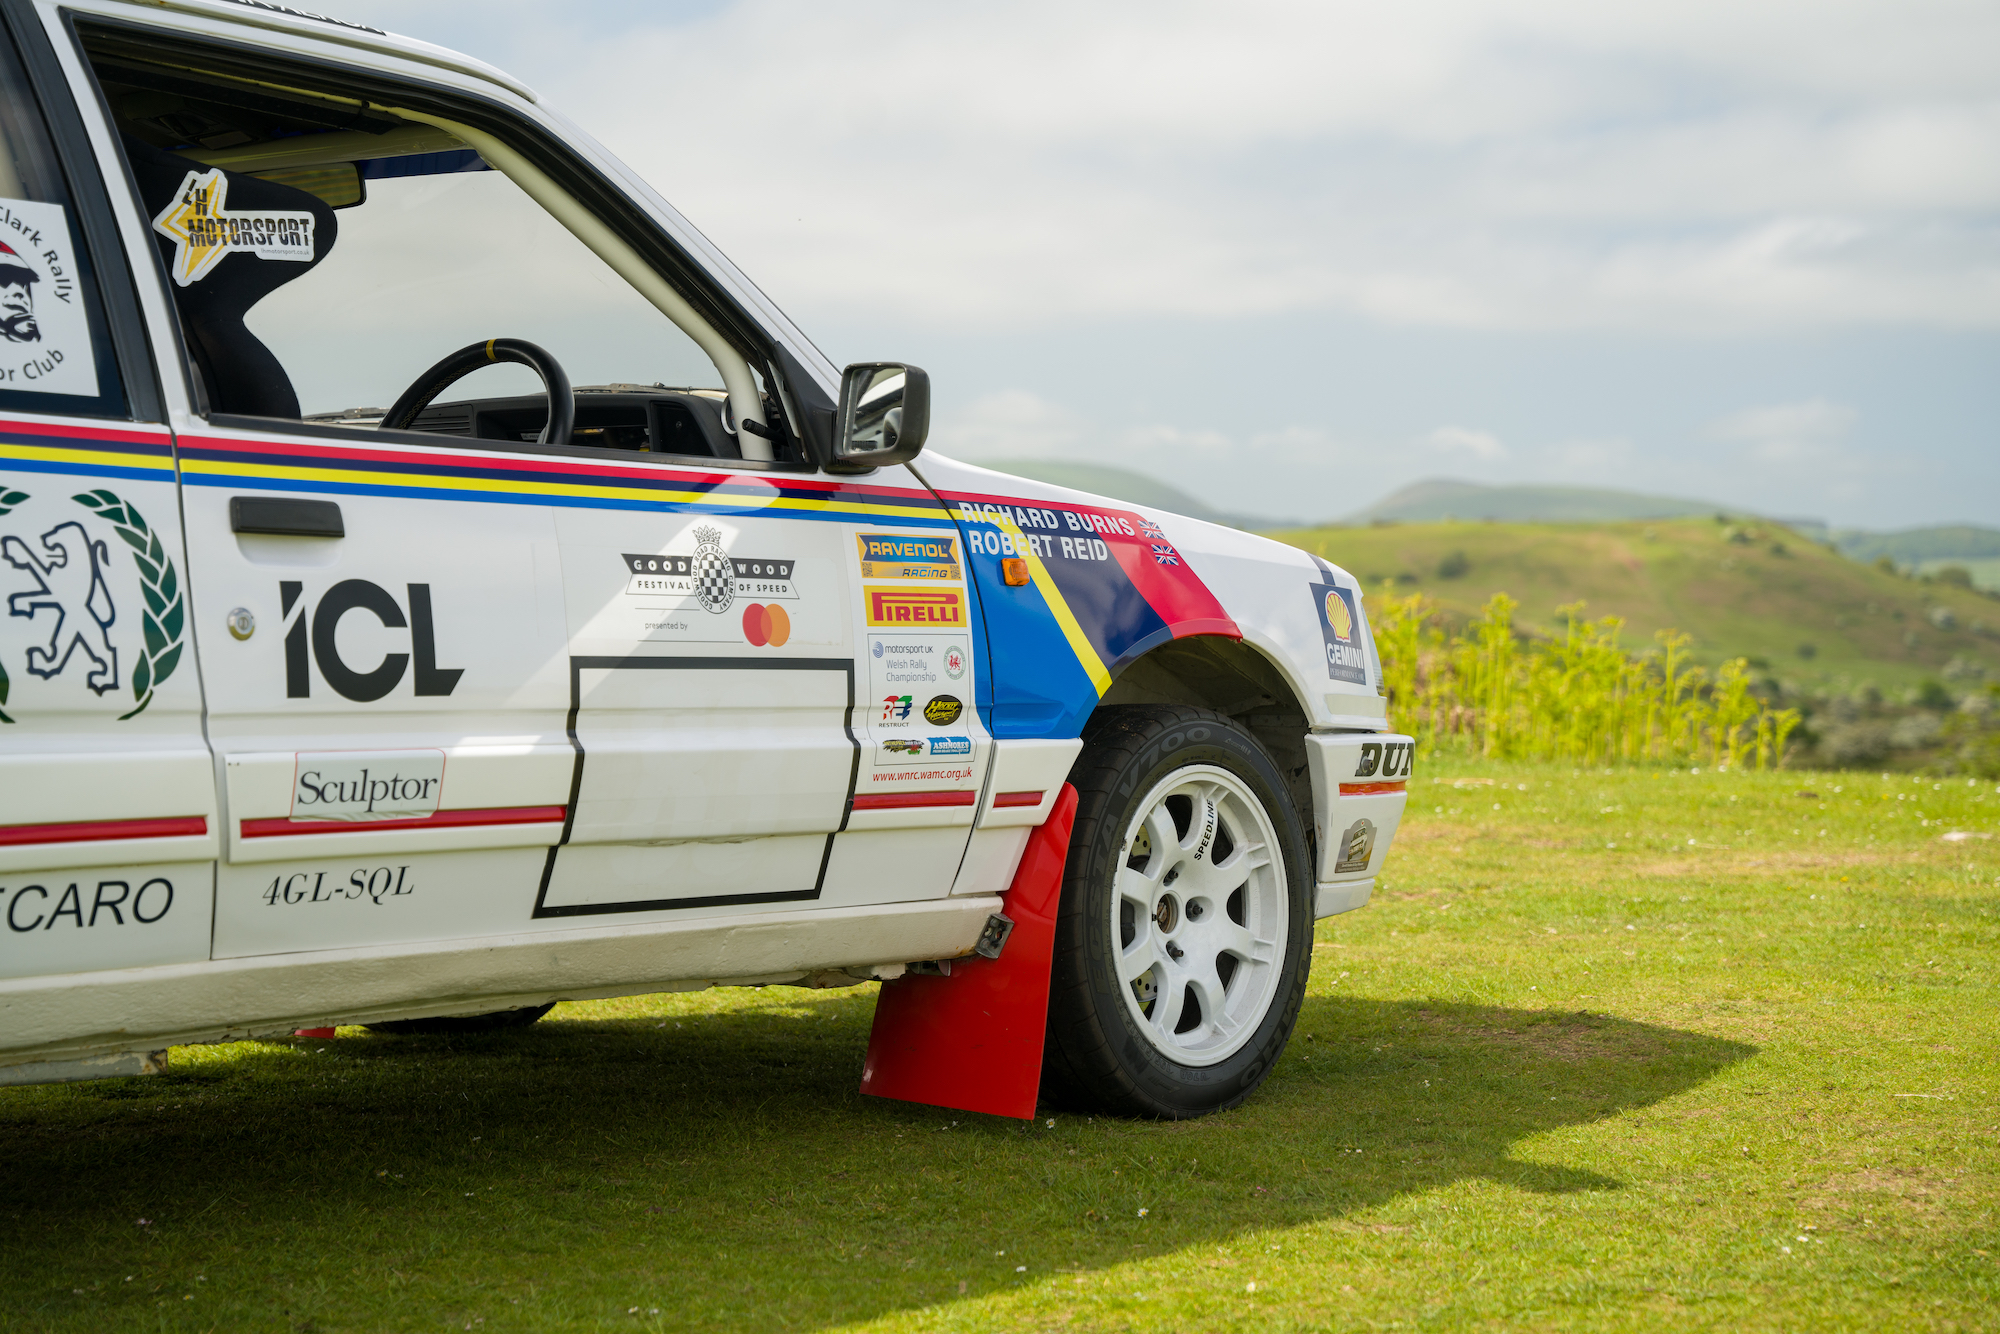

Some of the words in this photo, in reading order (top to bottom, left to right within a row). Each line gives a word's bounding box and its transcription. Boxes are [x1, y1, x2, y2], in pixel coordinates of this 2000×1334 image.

[187, 218, 309, 248] MOTORSPORT
[0, 206, 43, 247] lark
[43, 249, 72, 304] Rally
[23, 349, 64, 380] Club
[958, 502, 1059, 530] RICHARD
[1063, 511, 1136, 537] BURNS
[694, 545, 708, 562] ROAD
[711, 545, 732, 571] RACING
[868, 541, 949, 558] RAVENOL
[968, 530, 1053, 558] ROBERT
[1060, 536, 1109, 561] REID
[633, 559, 687, 572] GOOD
[737, 563, 789, 576] WOOD
[902, 568, 948, 578] RACING
[637, 580, 691, 590] FESTIVAL
[739, 583, 752, 592] OF
[756, 583, 788, 593] SPEED
[693, 565, 713, 610] GOODWOOD
[719, 575, 734, 611] COMPANY
[871, 592, 959, 622] PIRELLI
[279, 579, 466, 703] ICL
[645, 621, 679, 632] presented
[680, 621, 688, 631] by
[885, 645, 924, 654] motorsport
[1327, 642, 1364, 670] GEMINI
[886, 660, 908, 669] Welsh
[910, 660, 927, 671] Rally
[886, 672, 937, 683] Championship
[933, 741, 970, 750] ASHMORES
[872, 766, 973, 781] www.wnrc.wamc.org.uk
[298, 769, 438, 813] Sculptor
[1193, 798, 1216, 861] SPEEDLINE
[1089, 813, 1120, 995] ECSTA
[1119, 726, 1212, 800] V700
[262, 866, 415, 907] 4GL-SQL
[0, 878, 174, 933] CARO
